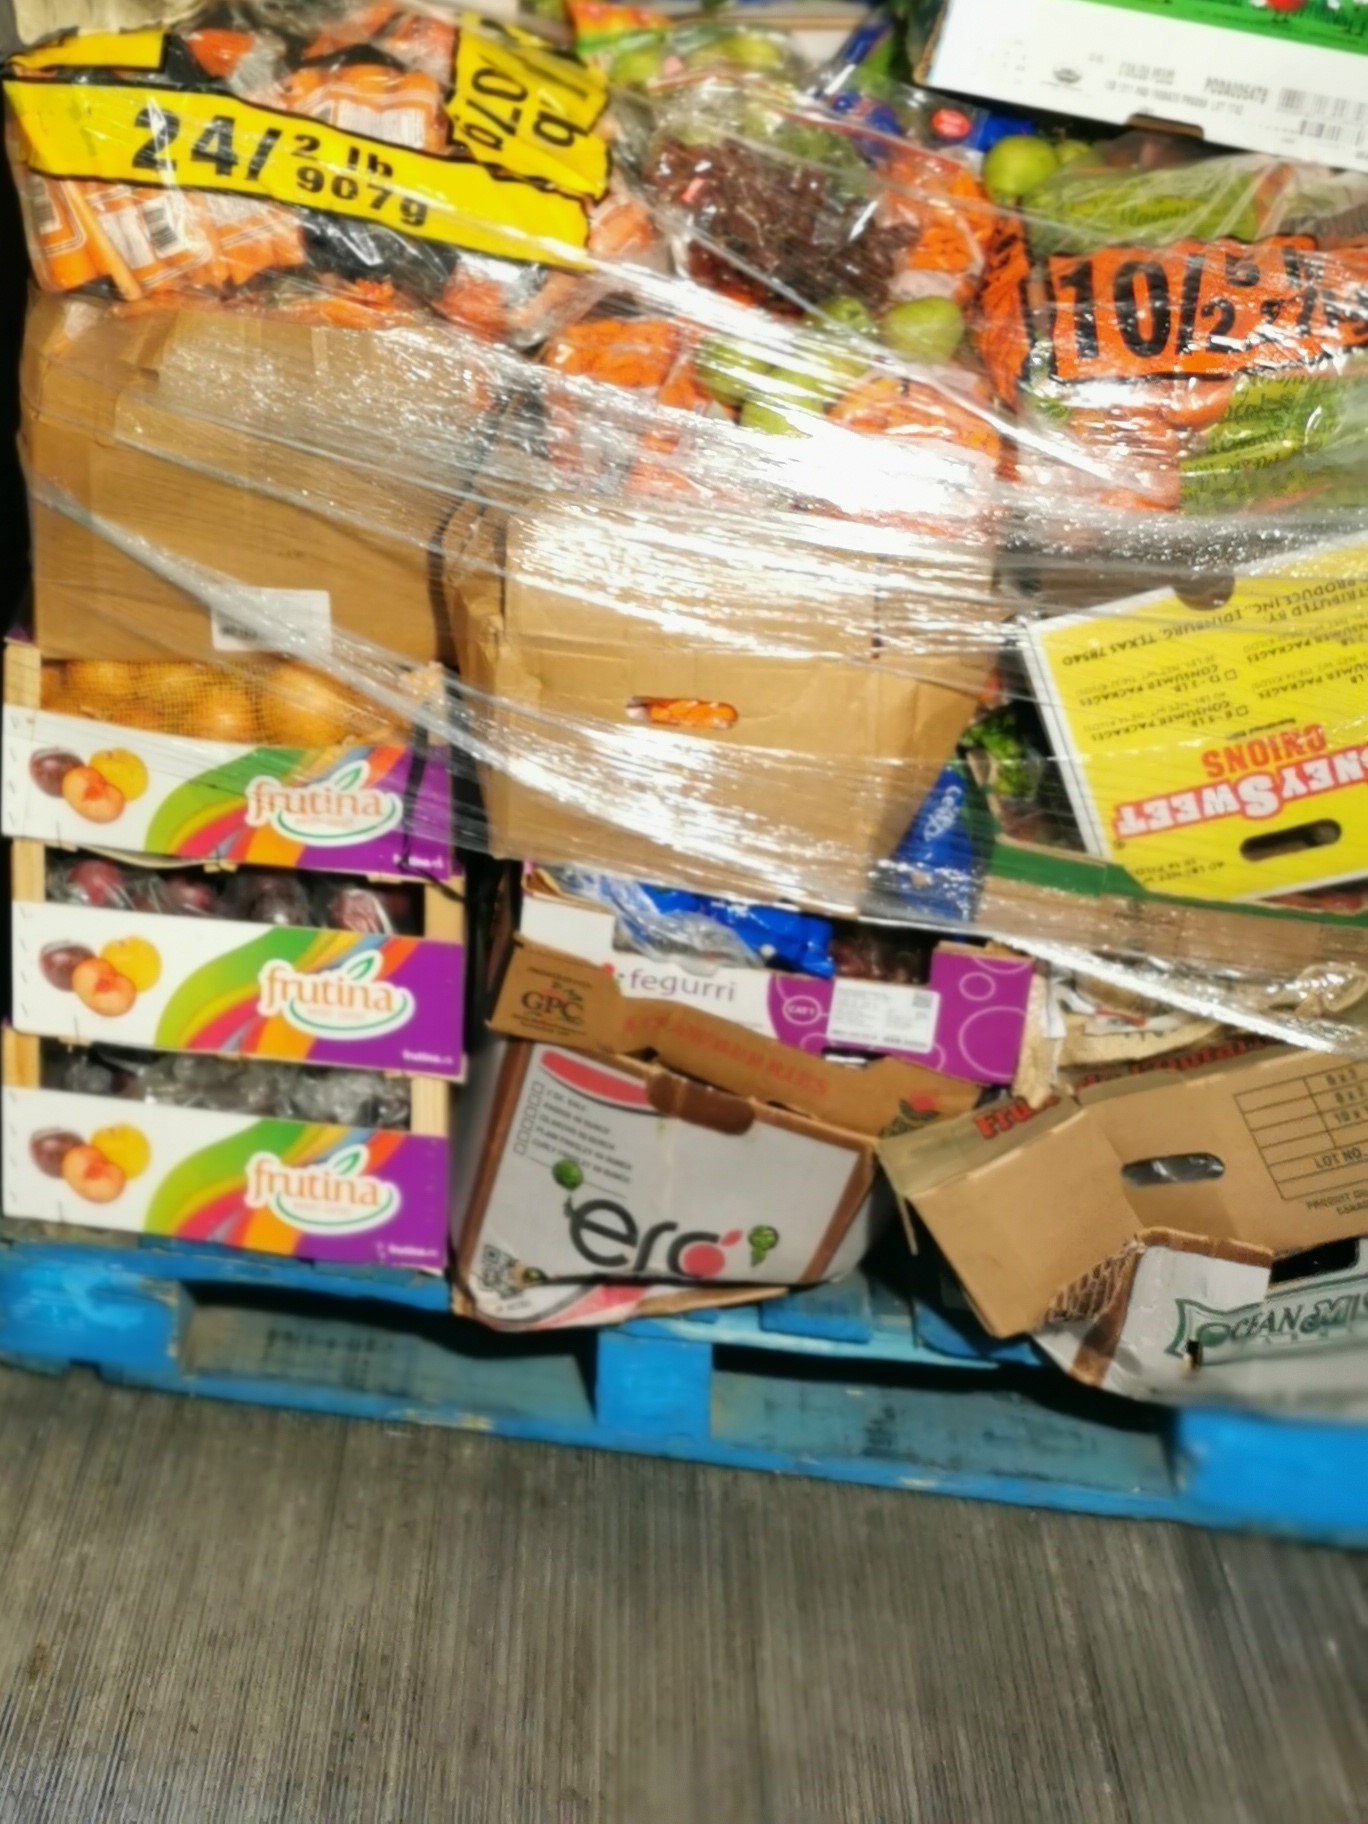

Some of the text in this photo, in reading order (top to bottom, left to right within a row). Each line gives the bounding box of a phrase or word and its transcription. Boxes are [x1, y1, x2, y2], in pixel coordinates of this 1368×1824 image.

[130, 105, 283, 185] 24/
[292, 133, 395, 179] 2 lb
[294, 165, 432, 232] 907g
[1058, 252, 1206, 359] 10/
[1282, 575, 1356, 605] PRODUCE
[1108, 631, 1157, 654] TEXAS
[1246, 638, 1312, 664] PACKAGES
[1256, 674, 1324, 700] PACKAGES
[1200, 723, 1329, 777] ONIONS
[252, 781, 383, 820] frutina
[265, 964, 395, 1013] frutina
[520, 990, 585, 1026] GPC
[1313, 1150, 1341, 1169] LOT
[252, 1158, 380, 1208] frutina
[1196, 1303, 1303, 1348] OCEAN
